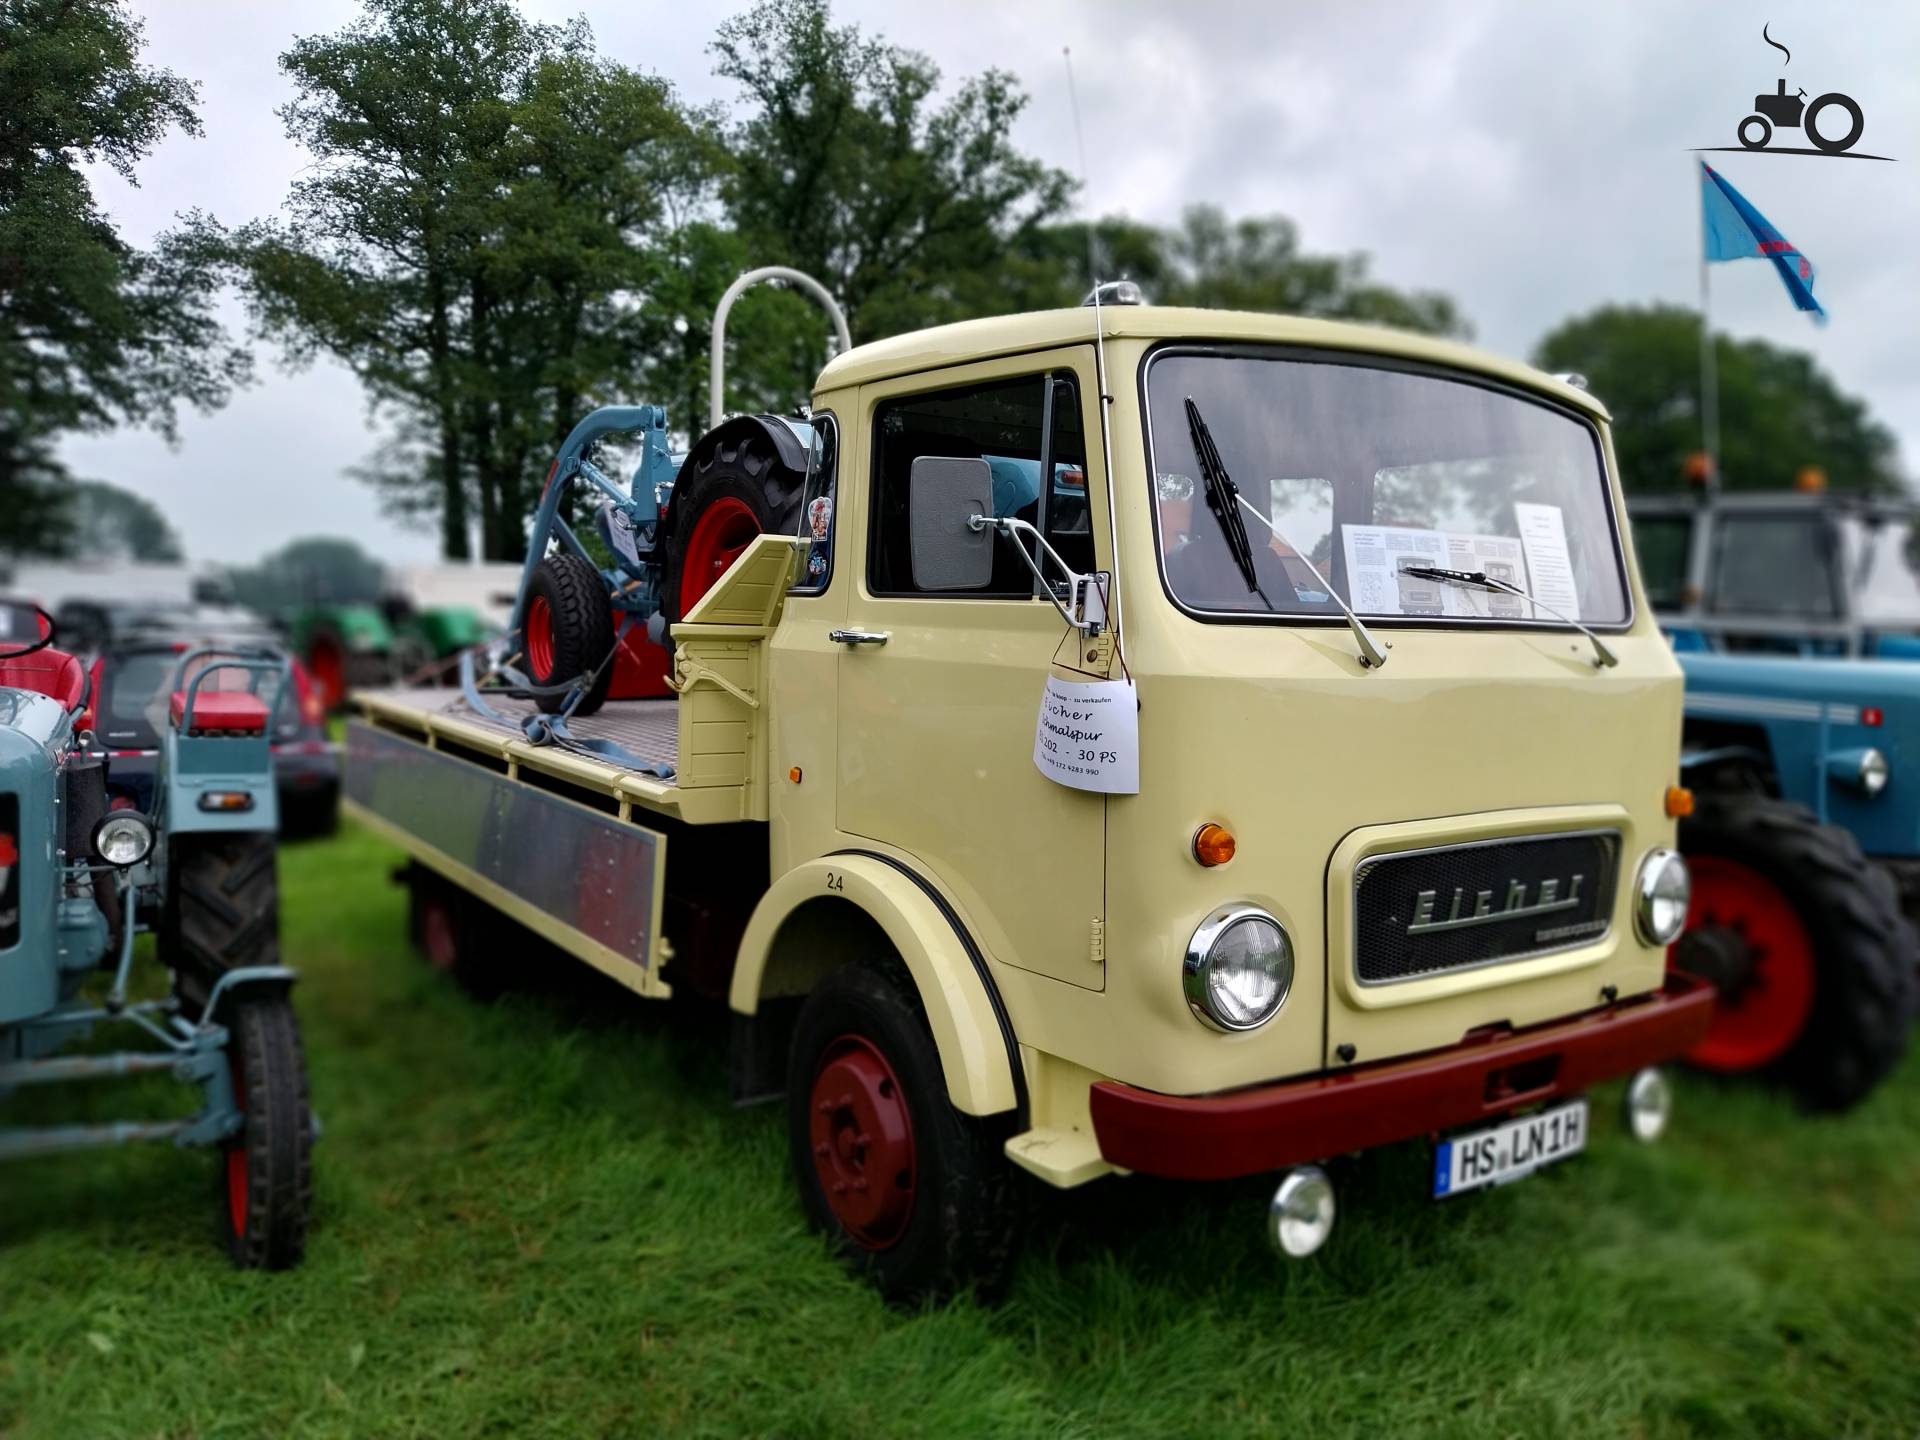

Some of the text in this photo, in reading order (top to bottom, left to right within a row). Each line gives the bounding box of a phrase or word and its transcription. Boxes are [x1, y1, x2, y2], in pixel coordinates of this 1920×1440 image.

[1078, 749, 1095, 761] 30
[1099, 751, 1117, 763] PS
[1055, 761, 1066, 770] 172
[1067, 765, 1083, 774] 4283
[1085, 768, 1099, 776] 990
[1459, 1136, 1497, 1182] HS
